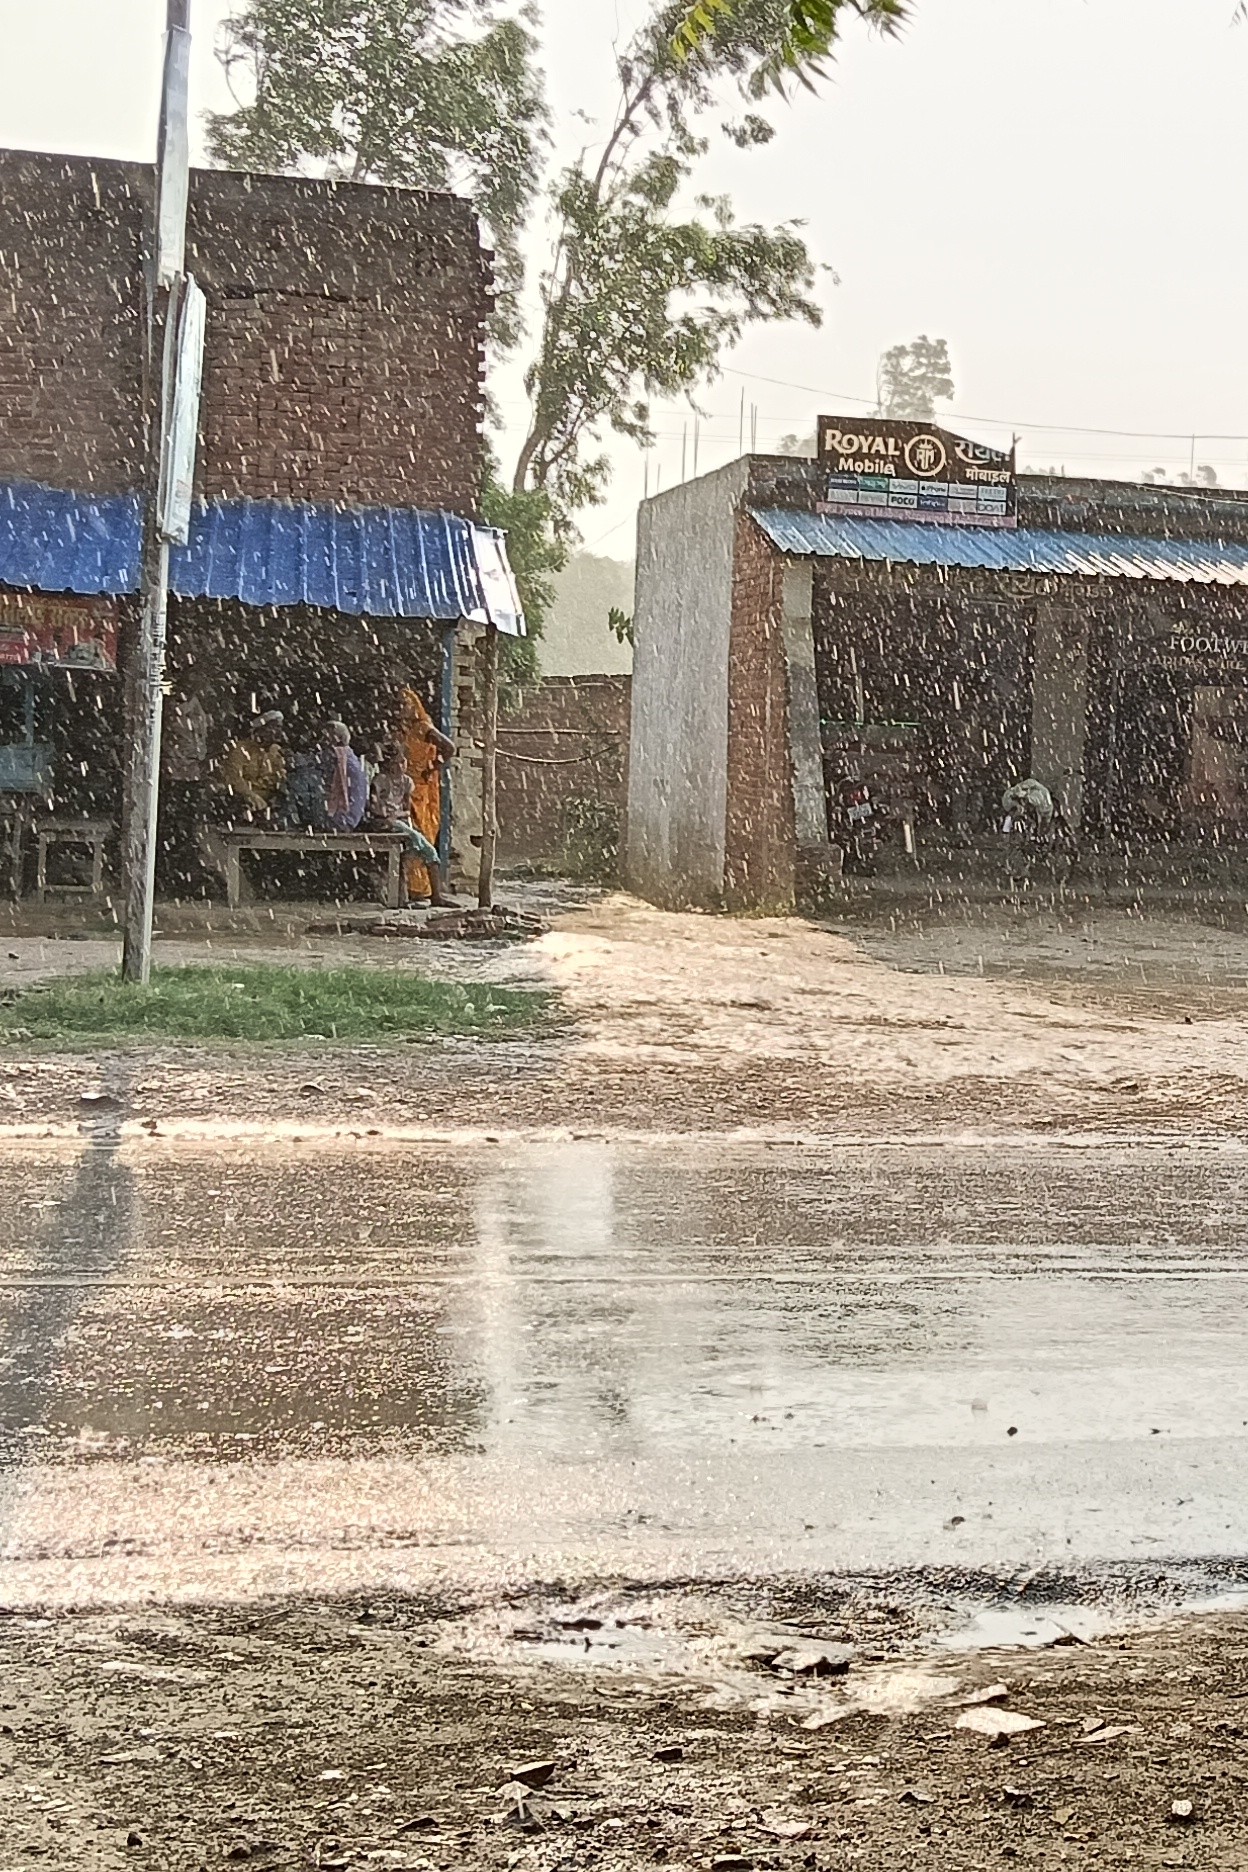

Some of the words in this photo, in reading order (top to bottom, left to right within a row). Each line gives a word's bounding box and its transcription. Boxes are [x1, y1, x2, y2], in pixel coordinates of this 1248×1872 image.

[825, 429, 900, 455] ROYAL
[838, 457, 895, 475] Mobile
[965, 466, 1011, 486] मोबाइल
